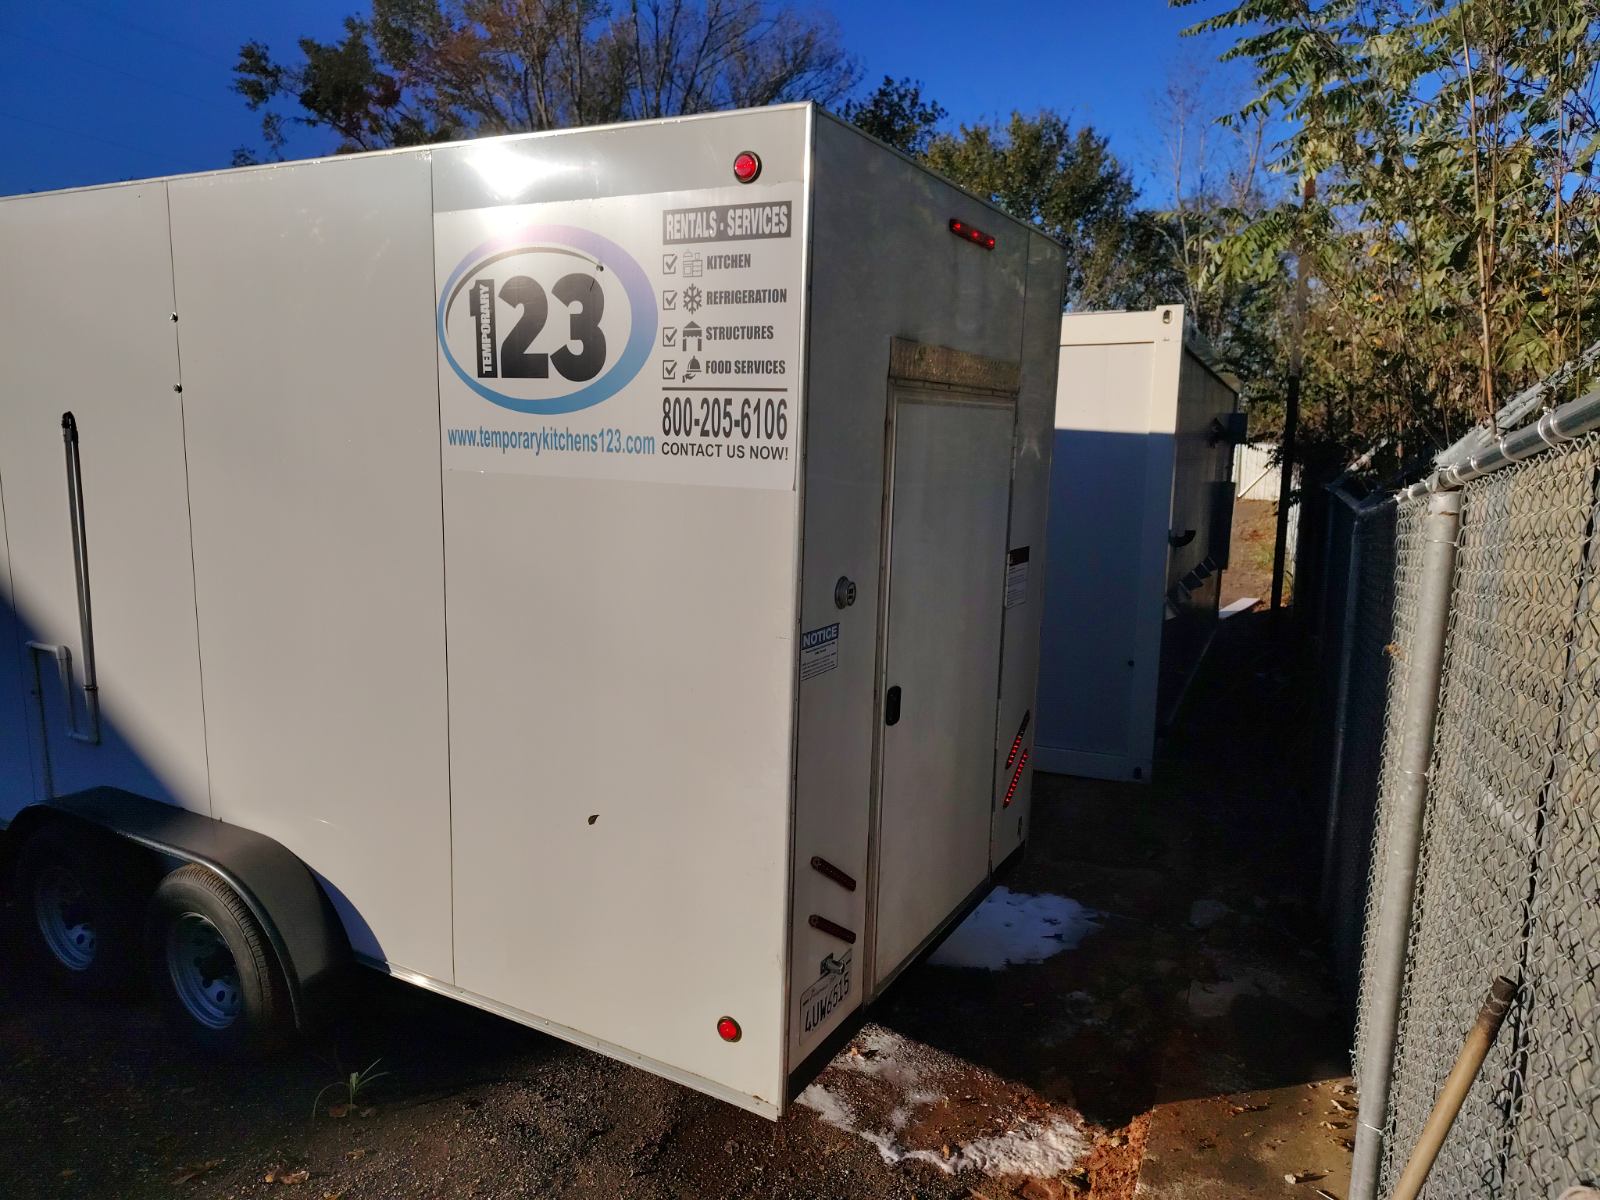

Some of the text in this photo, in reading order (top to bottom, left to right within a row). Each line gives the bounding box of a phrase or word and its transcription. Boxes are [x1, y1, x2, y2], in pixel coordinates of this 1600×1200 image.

[666, 210, 717, 240] RENTALS
[727, 205, 788, 236] SERVICES
[707, 254, 751, 270] KITCHEN
[706, 288, 788, 305] REFRIGERATION
[469, 272, 607, 382] 123
[479, 284, 493, 373] TEMPORARY
[706, 325, 774, 341] STRUCTURES
[705, 360, 785, 375] FOOD SERVICES
[662, 397, 788, 440] 800-205-6106
[447, 426, 656, 456] www.temporarykitchens123.com
[661, 442, 789, 461] CONTACT US NOW!
[803, 625, 838, 648] NOTICE
[804, 971, 850, 1034] 4UW6515
